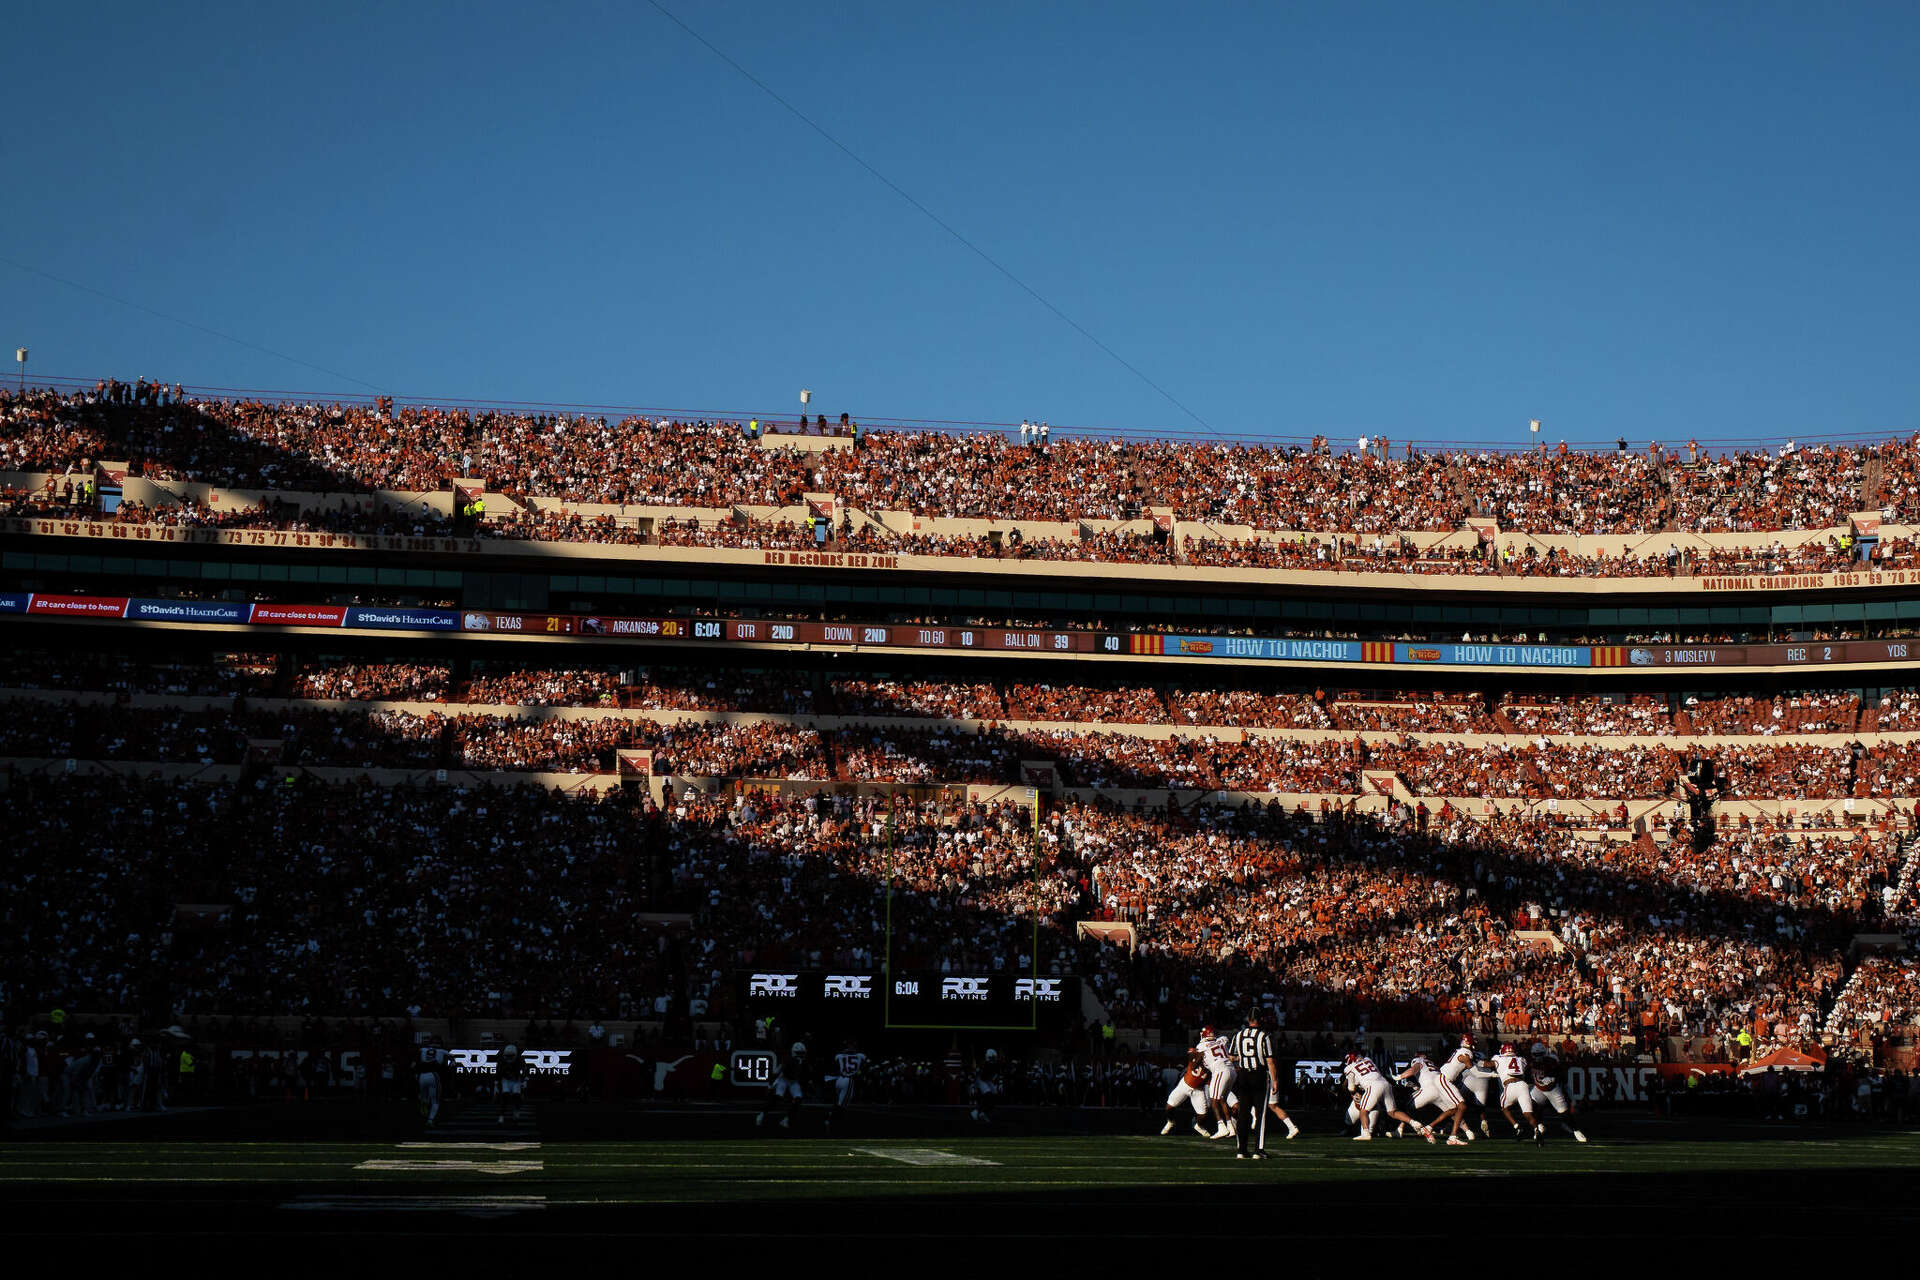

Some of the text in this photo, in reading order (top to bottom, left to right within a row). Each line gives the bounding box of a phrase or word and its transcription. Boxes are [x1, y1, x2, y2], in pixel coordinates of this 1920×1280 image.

[38, 521, 54, 533] '61
[60, 522, 79, 535] '62
[84, 523, 103, 536] '63
[132, 526, 150, 539] '69
[224, 531, 242, 543] '73
[247, 532, 264, 544] '75
[270, 532, 287, 545] '77
[765, 552, 898, 568] RED McCOMBS RED ZONE
[1703, 577, 1754, 590] NATIONAL
[1759, 576, 1824, 589] CHAMPIONS
[1833, 574, 1859, 586] 1963
[1864, 573, 1882, 585] '69
[66, 602, 87, 610] close
[287, 611, 307, 619] close
[317, 612, 338, 620] home
[495, 616, 559, 632] TEXAS 21
[662, 621, 677, 636] 20
[695, 622, 720, 637] 6:04
[737, 624, 793, 640] QTR 2ND
[824, 627, 886, 642] DOWN 2ND
[919, 630, 973, 645] TO GO 10
[1005, 633, 1069, 648] BALL ON 39
[1104, 637, 1119, 650] 40
[1226, 639, 1347, 659] HOW TO NACHO!
[1455, 646, 1577, 664] HOW TO NACHO!
[1665, 650, 1716, 663] 3 MOSLEY V
[1787, 647, 1831, 661] REC 2
[1888, 645, 1907, 657] YDS
[750, 990, 796, 998] PAVING
[895, 981, 919, 996] 6:04
[942, 993, 987, 1001] PAVING
[1242, 1037, 1255, 1057] C
[738, 1057, 769, 1081] 40
[1508, 1058, 1520, 1073] 4
